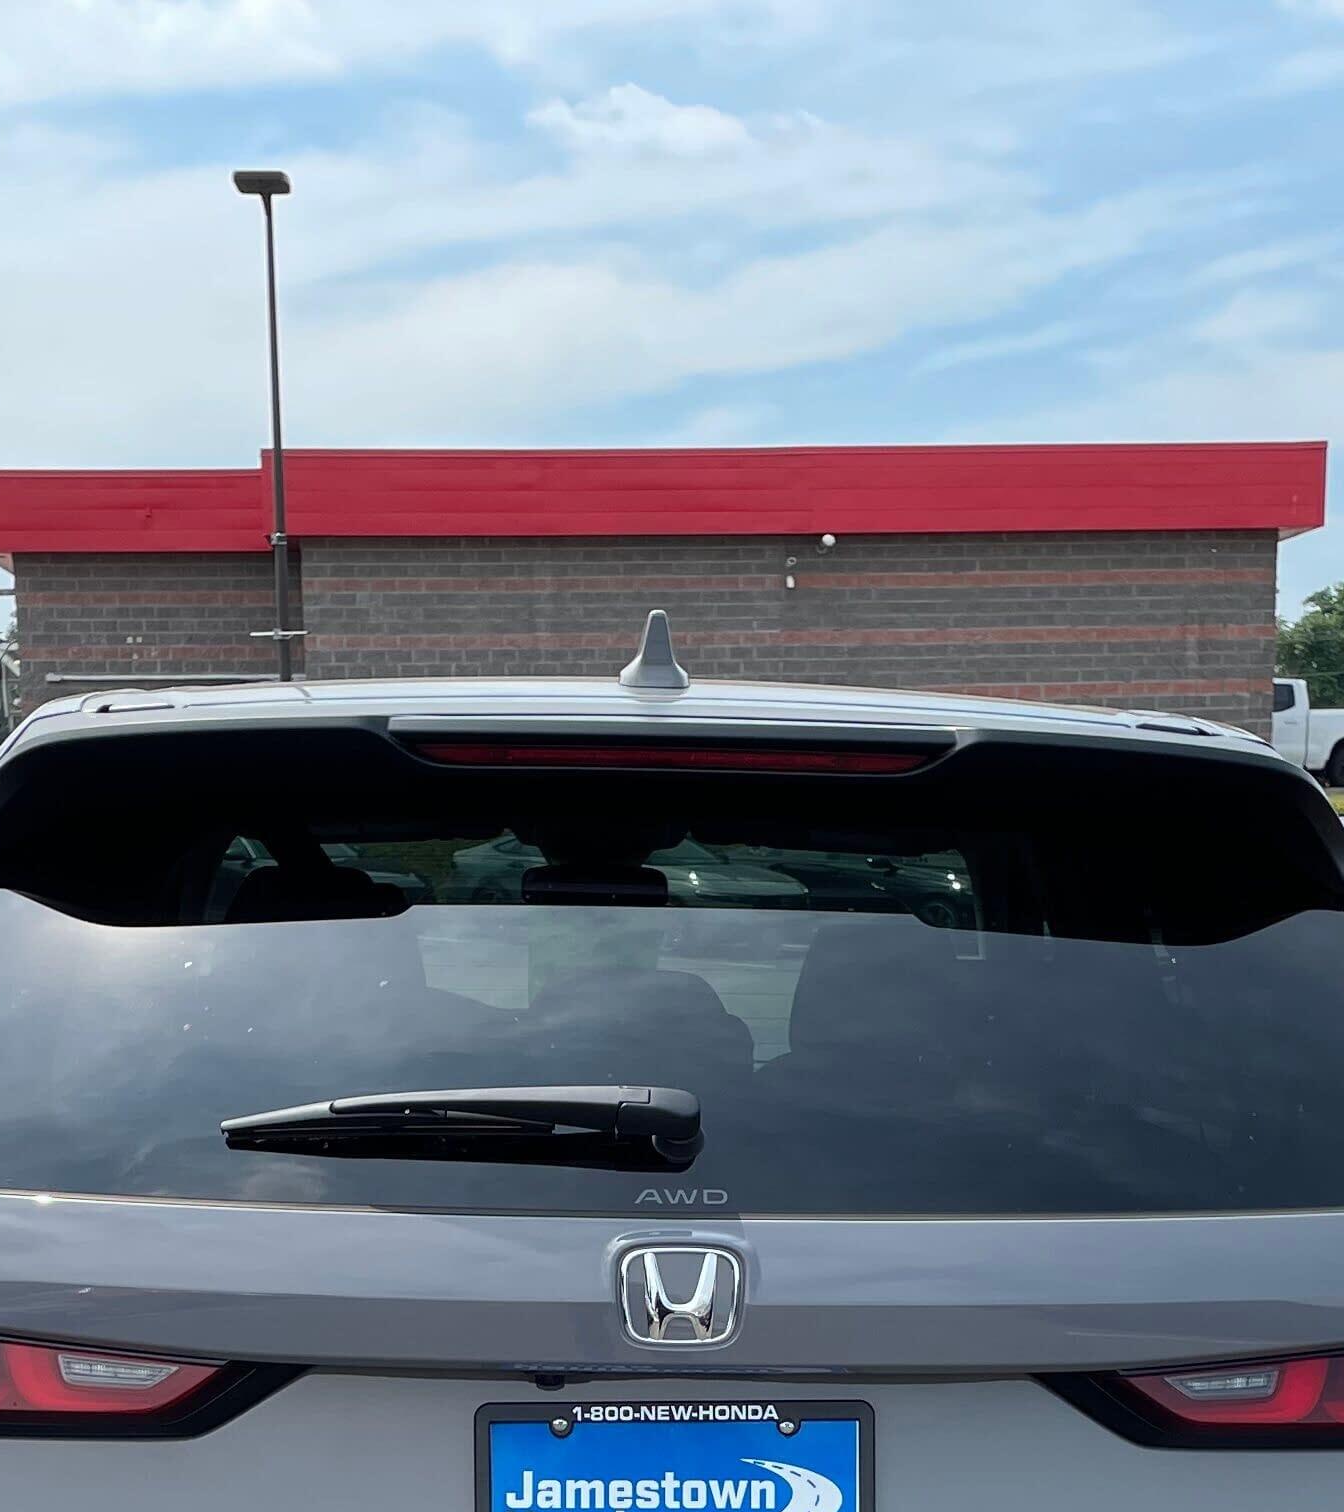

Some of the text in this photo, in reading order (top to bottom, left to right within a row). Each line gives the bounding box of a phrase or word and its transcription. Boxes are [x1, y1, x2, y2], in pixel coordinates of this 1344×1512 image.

[634, 1188, 729, 1205] AWD
[572, 1404, 779, 1422] 1-800-NEW-HONDA
[505, 1470, 776, 1510] Jamestown
